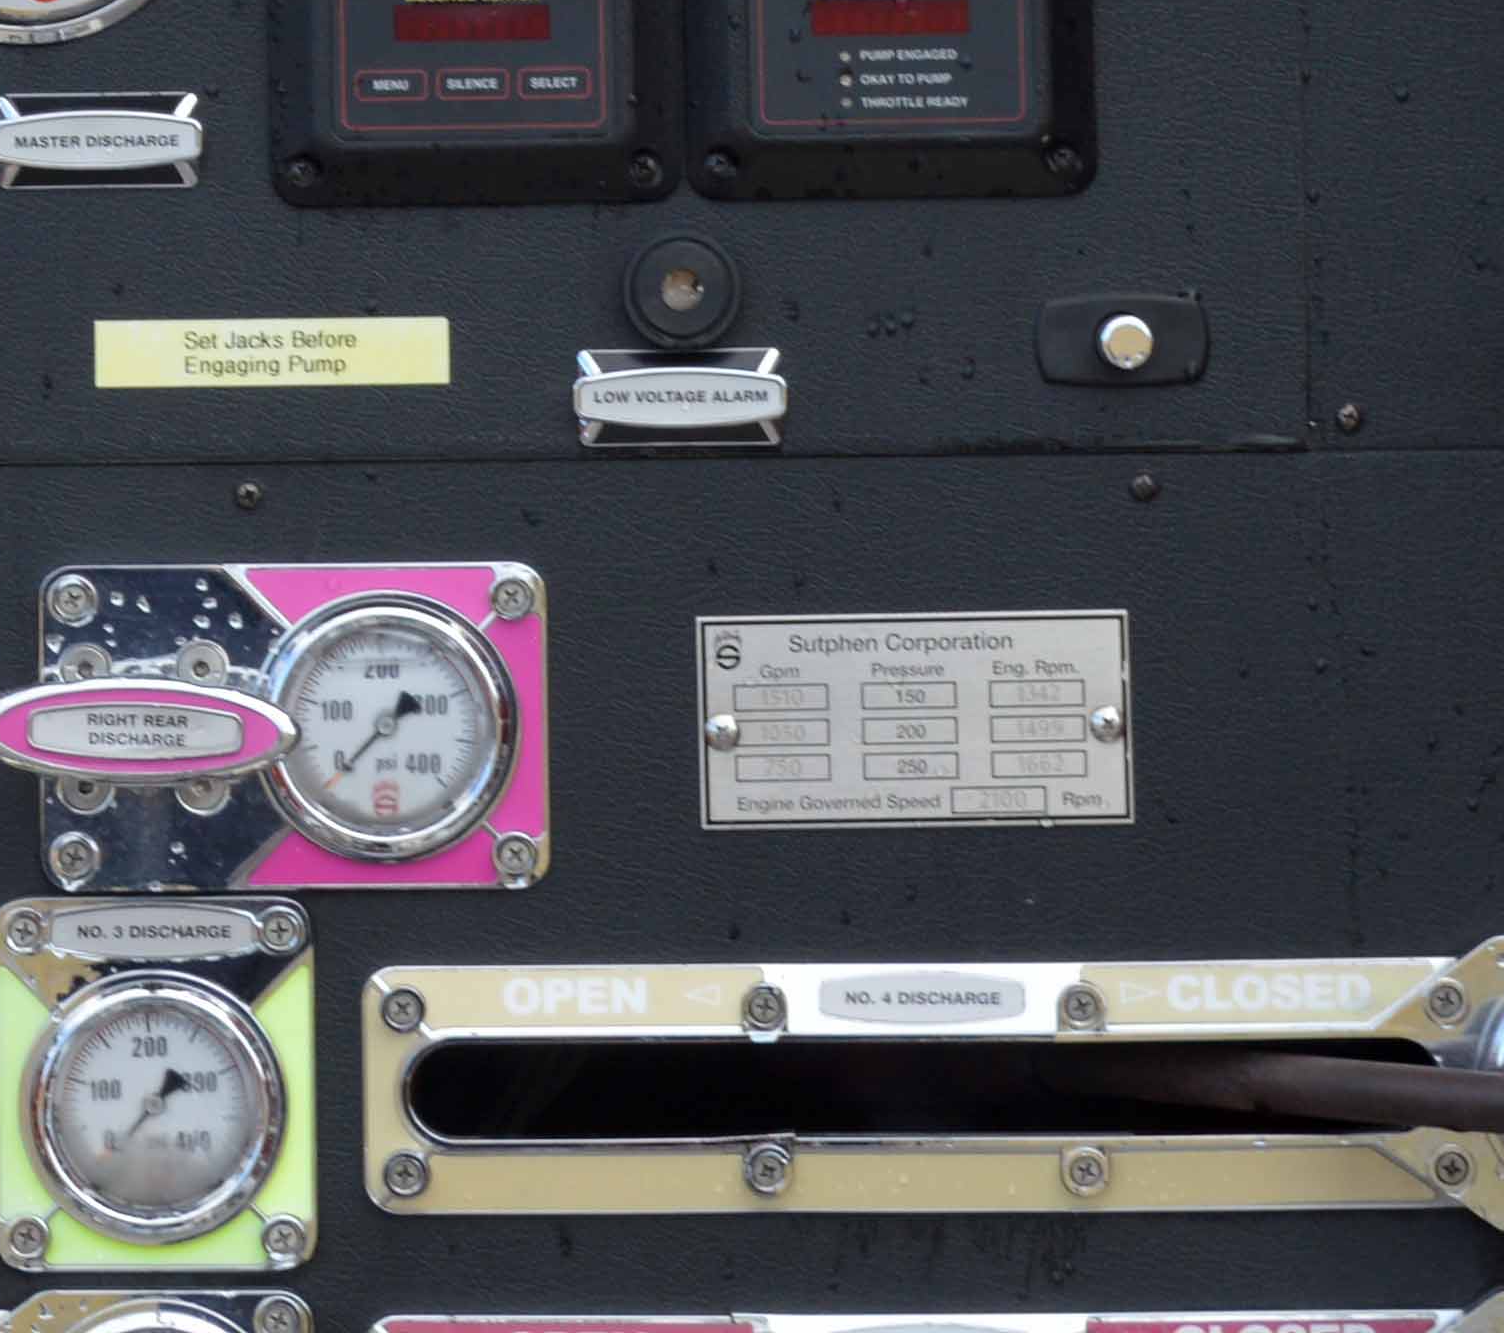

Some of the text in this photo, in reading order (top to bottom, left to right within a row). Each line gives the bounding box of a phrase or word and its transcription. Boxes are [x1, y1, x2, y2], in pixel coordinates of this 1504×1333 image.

[372, 78, 409, 90] MENU
[530, 76, 577, 89] SELECT
[14, 133, 180, 150] MASTER DISCHARGE
[183, 328, 358, 350] Set Jacks Before
[183, 354, 347, 377] Engaging Pump
[593, 389, 769, 404] LOW VOLTAGE ALARM
[789, 632, 1014, 656] Sutphen Corporation
[759, 665, 800, 681] Gpm
[871, 663, 945, 678] Pressure
[992, 660, 1080, 677] Eng. Rpm.
[896, 690, 926, 704] 150
[87, 712, 189, 729] RIGHT REAR
[87, 731, 186, 748] DISCHARGE
[896, 725, 926, 739] 200
[897, 760, 928, 774] 250
[736, 795, 942, 812] Engine Governed Speed
[77, 924, 232, 939] NO. 3 DISCHARGE
[502, 977, 648, 1016] OPEN
[844, 990, 1002, 1007] NO. 4 DISCHARGE
[1165, 972, 1374, 1013] CLOSED
